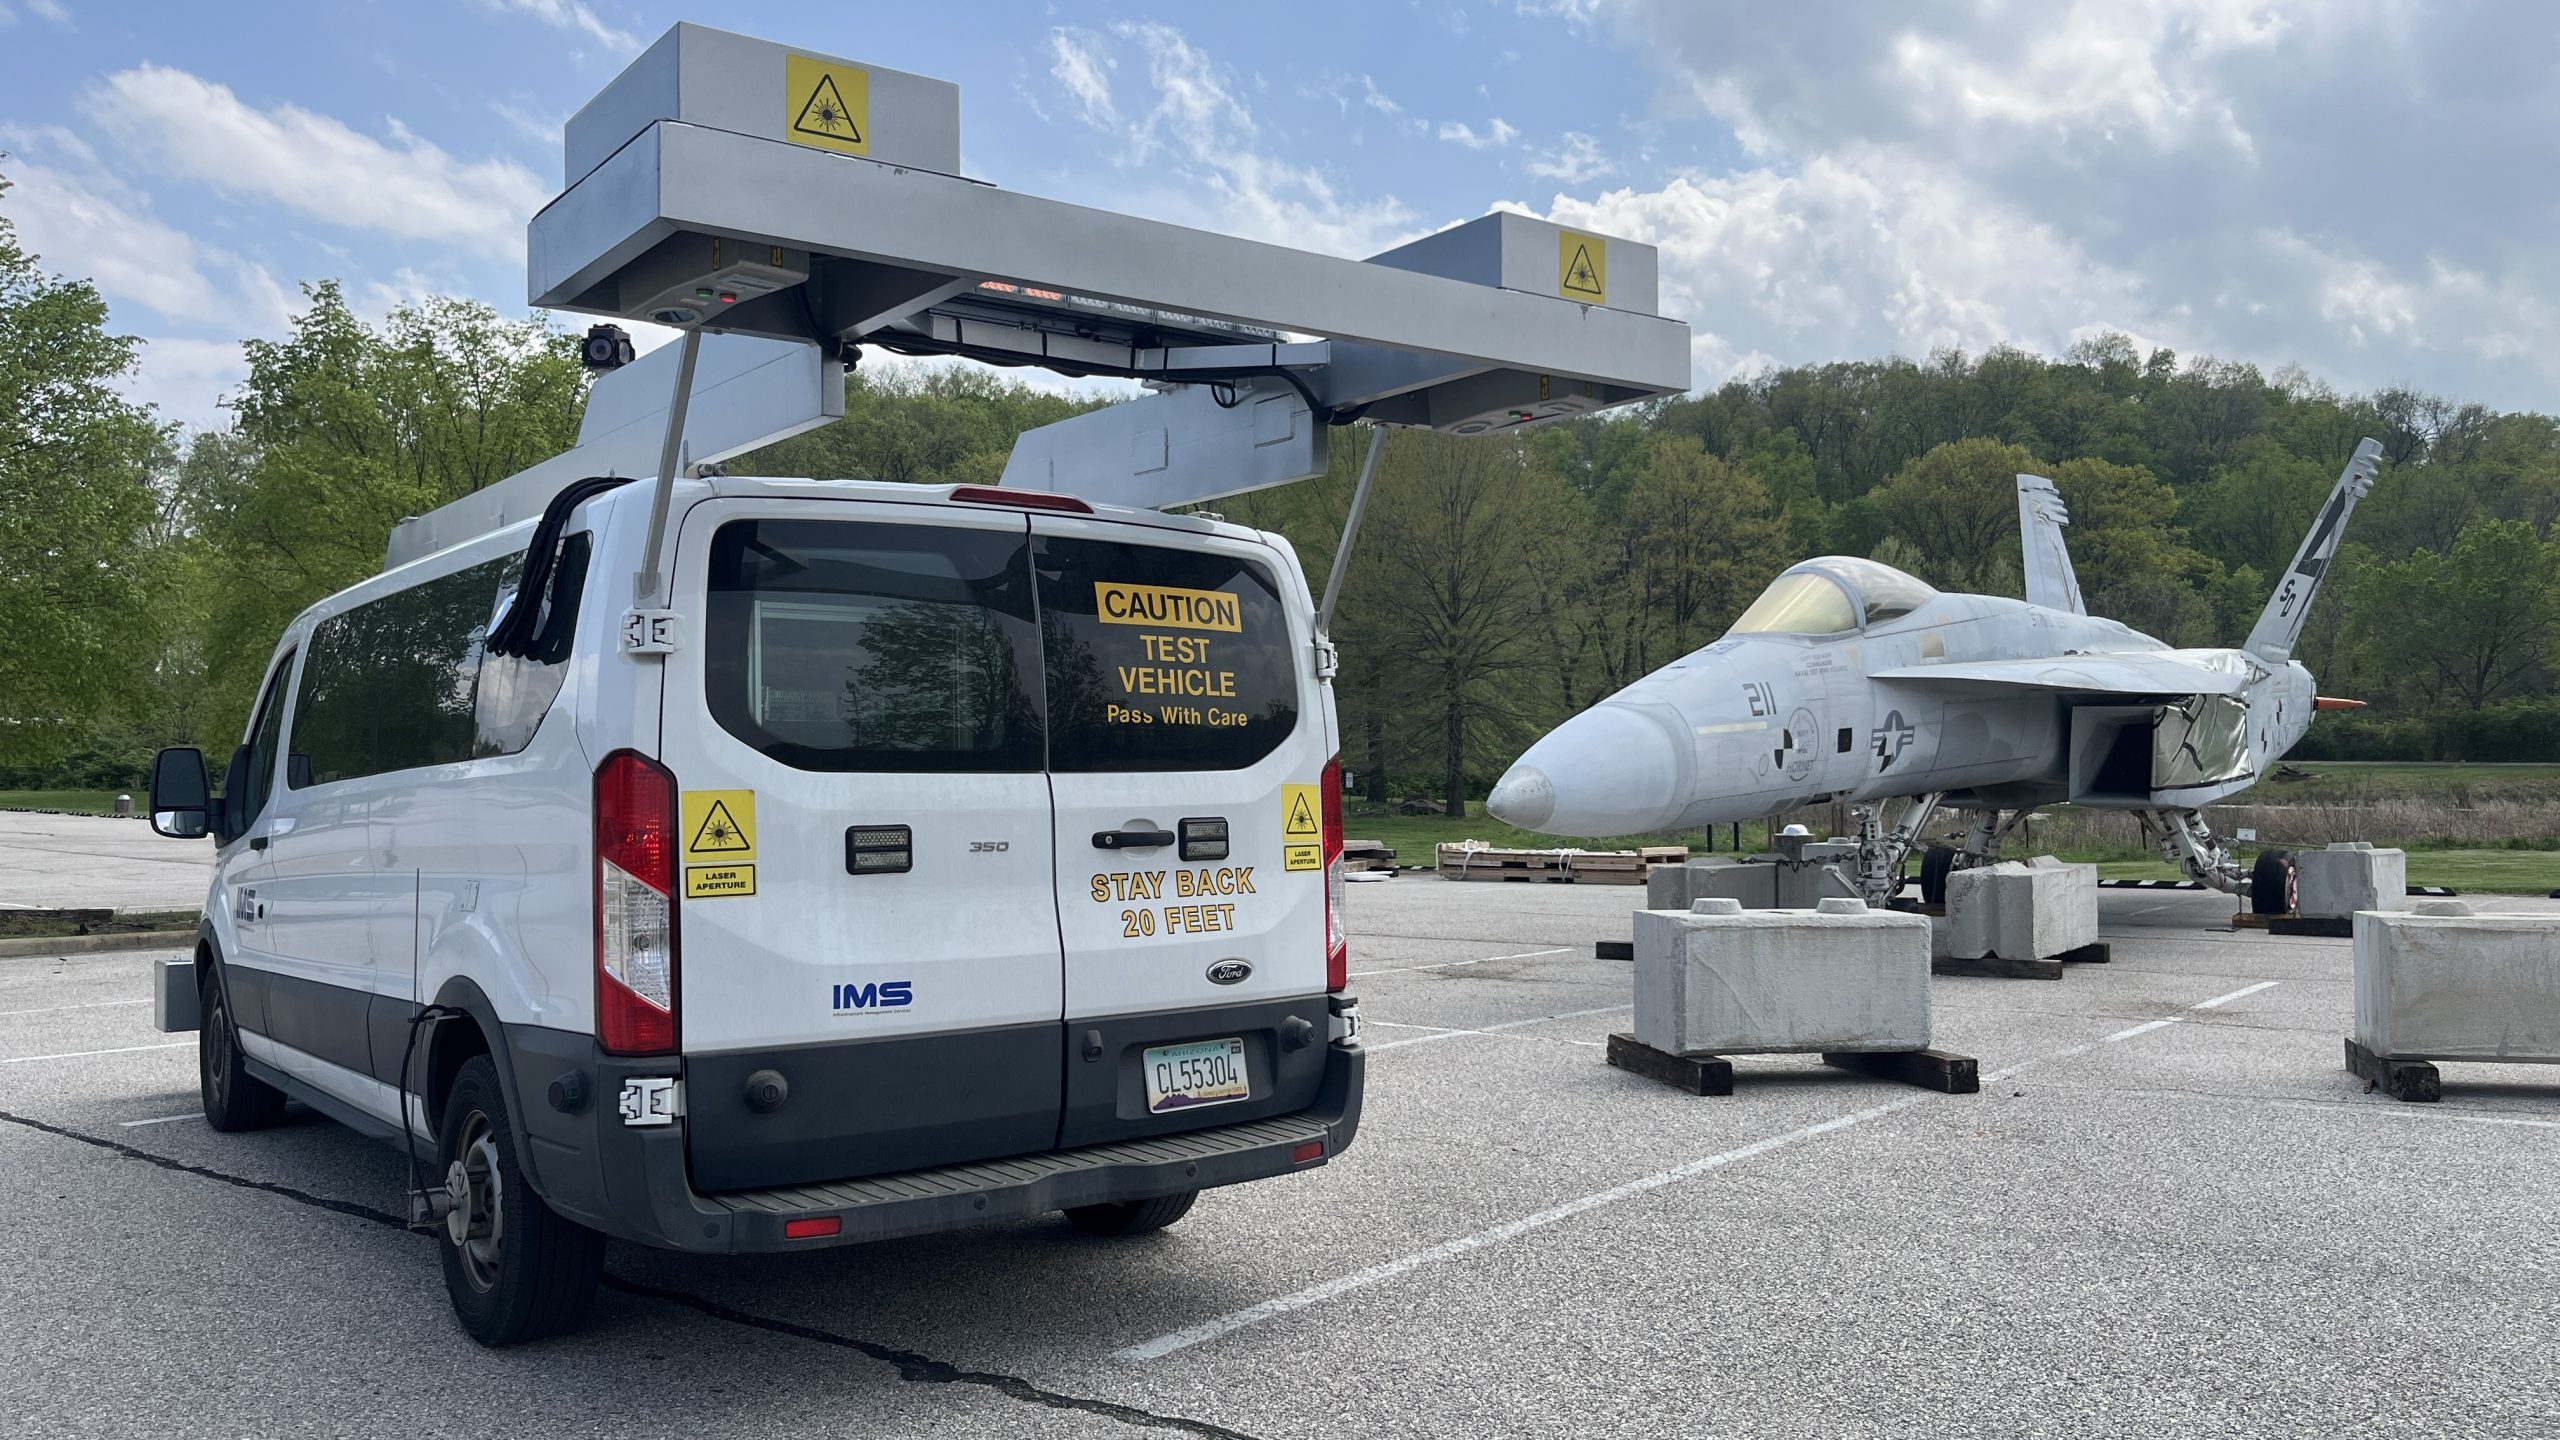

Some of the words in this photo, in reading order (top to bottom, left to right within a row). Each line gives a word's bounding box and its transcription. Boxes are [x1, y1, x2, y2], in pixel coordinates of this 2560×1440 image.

[1104, 590, 1236, 626] CAUTION
[1139, 635, 1210, 664] TEST
[1118, 667, 1236, 697] VEHICLE
[1742, 681, 1777, 717] 211
[1107, 704, 1153, 724] Pass
[1160, 706, 1201, 725] With
[1207, 708, 1248, 727] Care
[1786, 760, 1814, 774] HORNET
[969, 841, 1010, 853] 350
[695, 881, 746, 891] APERTURE
[705, 872, 737, 880] LASER
[1091, 870, 1167, 903] STAY
[1175, 867, 1256, 897] BACK
[236, 886, 257, 922] IMS
[1121, 908, 1156, 938] 20
[1164, 904, 1235, 934] FEET
[1218, 964, 1244, 979] Ford
[833, 981, 913, 1010] IMS
[1171, 1046, 1219, 1057] ARIZONA
[1156, 1054, 1238, 1095] CL55304
